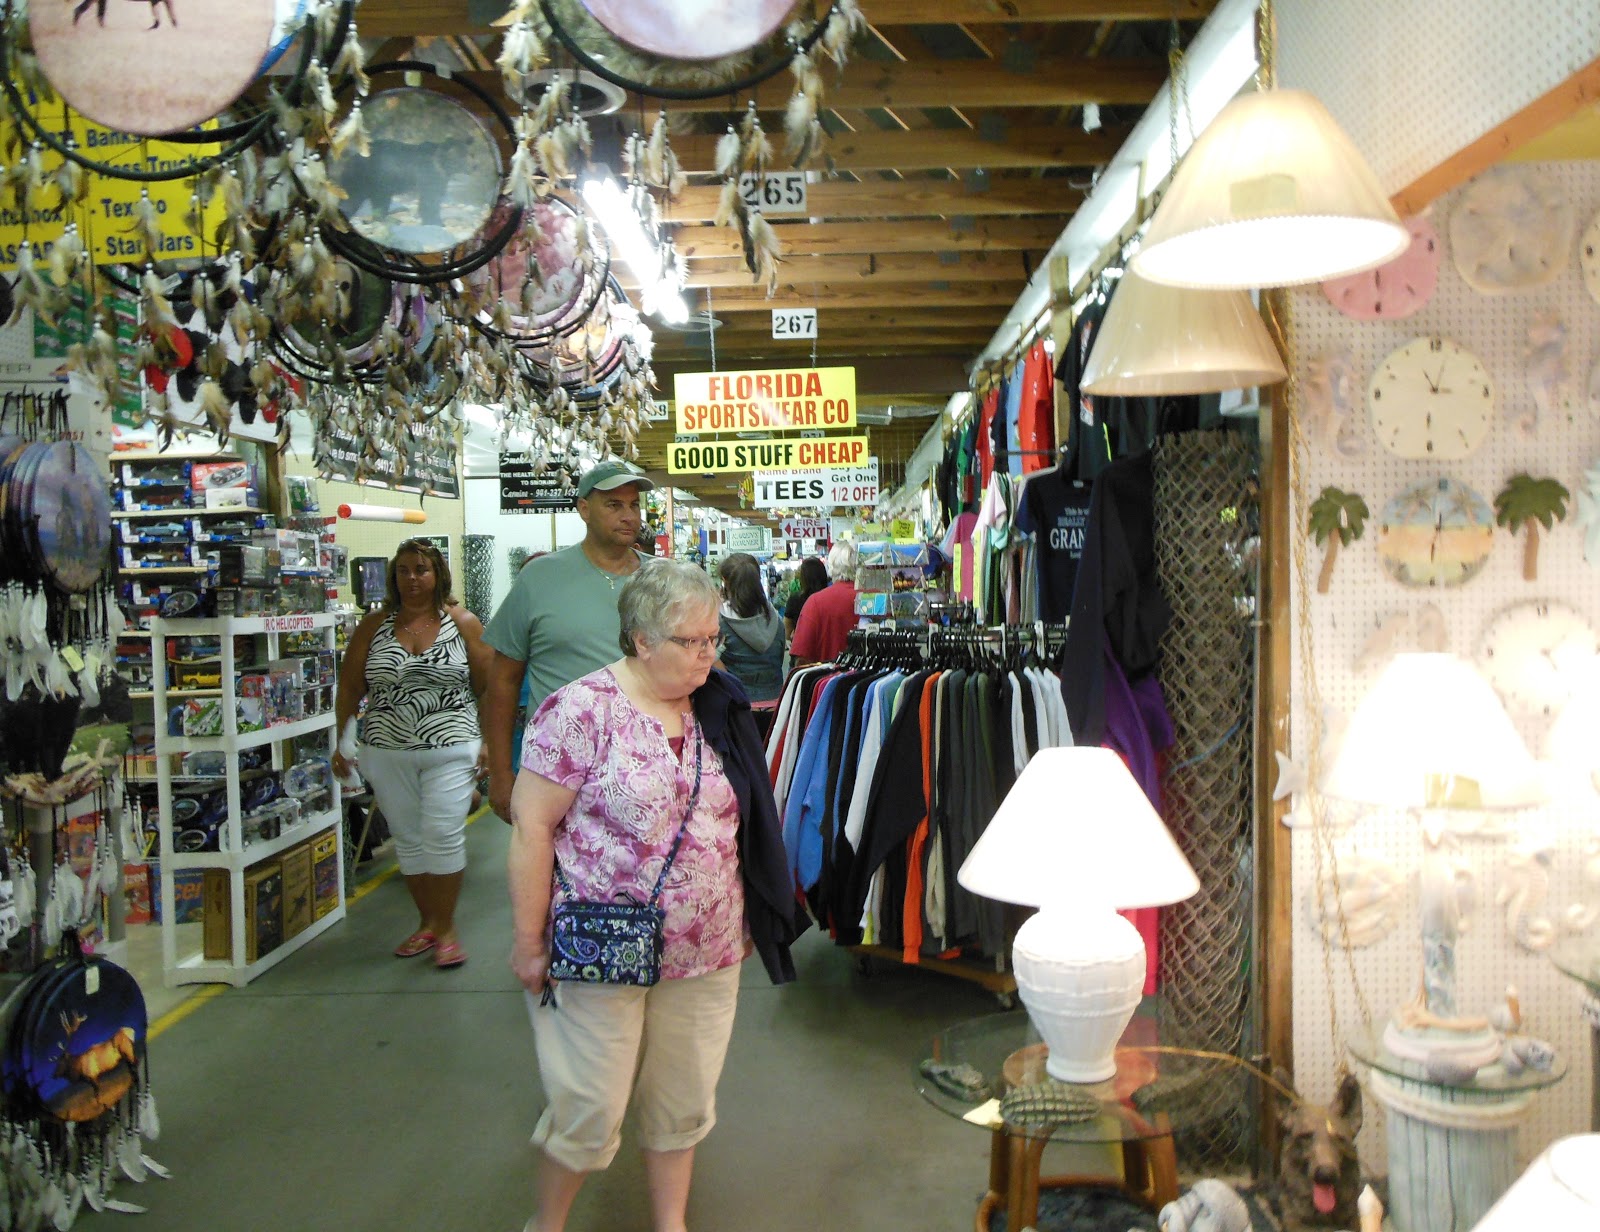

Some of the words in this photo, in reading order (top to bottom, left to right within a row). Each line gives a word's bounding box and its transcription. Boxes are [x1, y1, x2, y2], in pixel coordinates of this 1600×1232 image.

[743, 177, 803, 205] 265
[101, 198, 167, 218] Texo
[106, 236, 142, 256] Star
[775, 315, 814, 333] 267
[708, 372, 823, 401] FLORIDA
[684, 400, 817, 430] SPORTSWEAR
[823, 398, 849, 424] CO
[674, 446, 729, 470] GOOD
[735, 444, 793, 468] STUFF
[799, 441, 863, 465] CHEAP
[831, 474, 851, 483] Get
[855, 473, 877, 482] One
[757, 479, 824, 500] TEES
[831, 486, 848, 502] 1/2
[853, 486, 877, 502] OFF
[793, 527, 826, 538] EXIT
[796, 519, 820, 527] FIRE
[276, 616, 314, 630] HELICOPTERS
